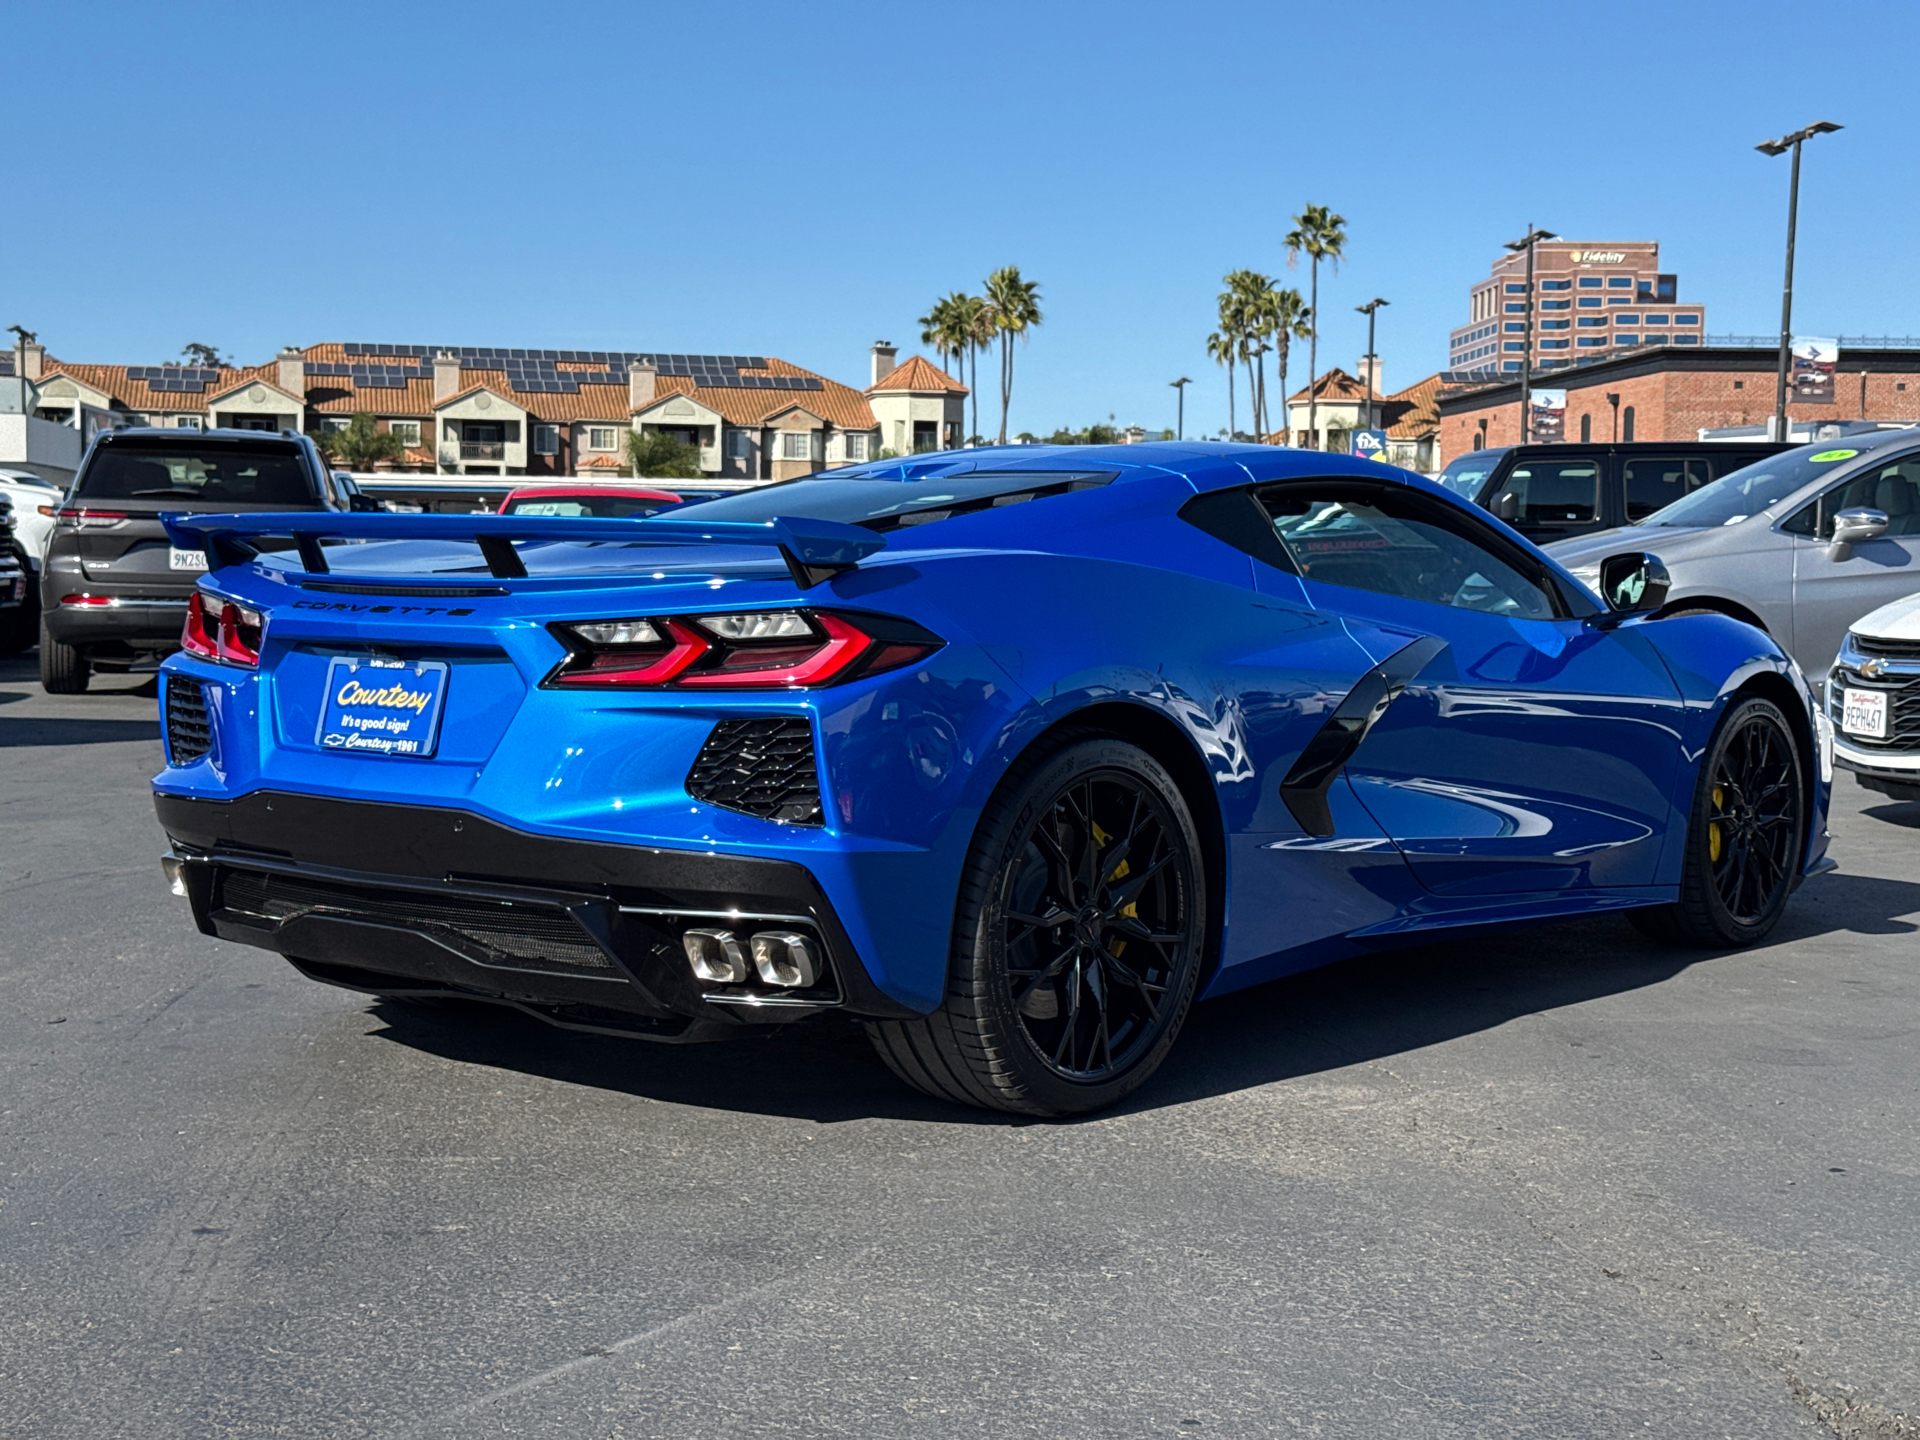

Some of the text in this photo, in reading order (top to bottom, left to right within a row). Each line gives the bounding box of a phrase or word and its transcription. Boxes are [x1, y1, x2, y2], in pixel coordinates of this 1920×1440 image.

[1582, 251, 1626, 264] Fidelity
[1356, 432, 1383, 449] fix
[292, 601, 477, 616] CORVETTE
[337, 681, 432, 715] Courtesy
[341, 714, 410, 734] It's a good sign!
[1845, 706, 1882, 731] 9EPH467
[345, 732, 418, 753] Courtesy 1961
